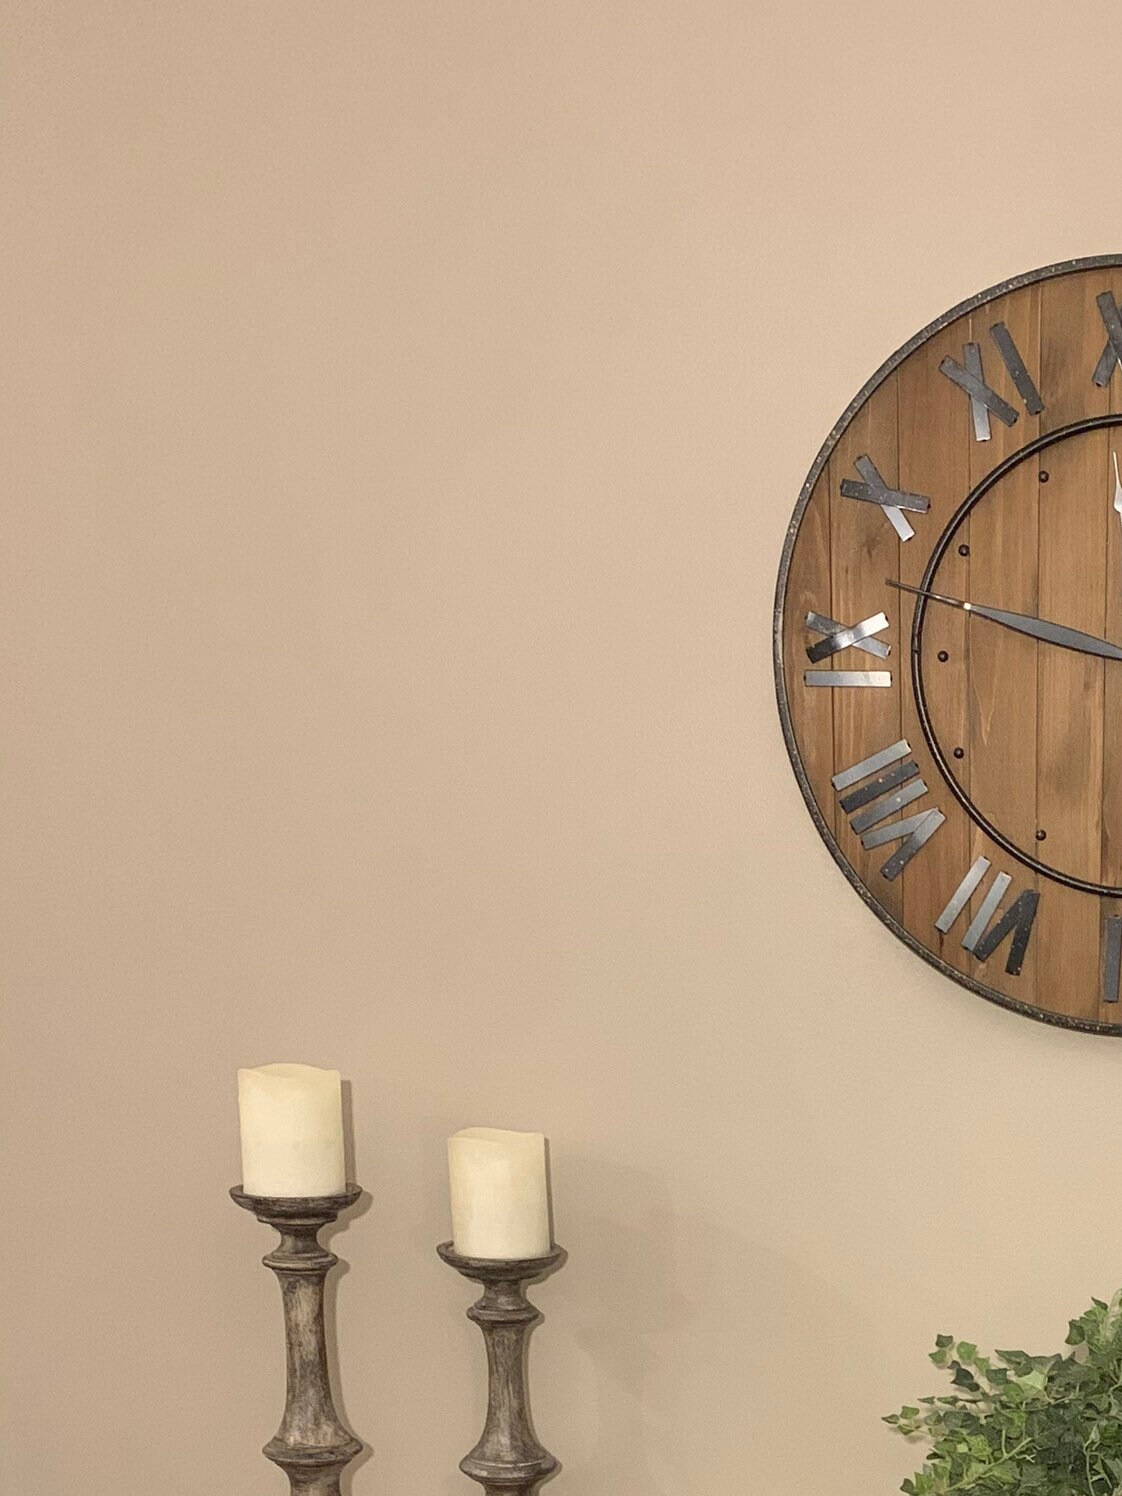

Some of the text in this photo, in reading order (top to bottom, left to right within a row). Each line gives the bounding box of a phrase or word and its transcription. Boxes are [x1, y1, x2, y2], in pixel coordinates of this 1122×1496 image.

[939, 321, 1044, 442] XI
[840, 454, 931, 542] X
[804, 611, 892, 687] IX
[831, 738, 946, 881] VIII
[935, 855, 1040, 976] VII
